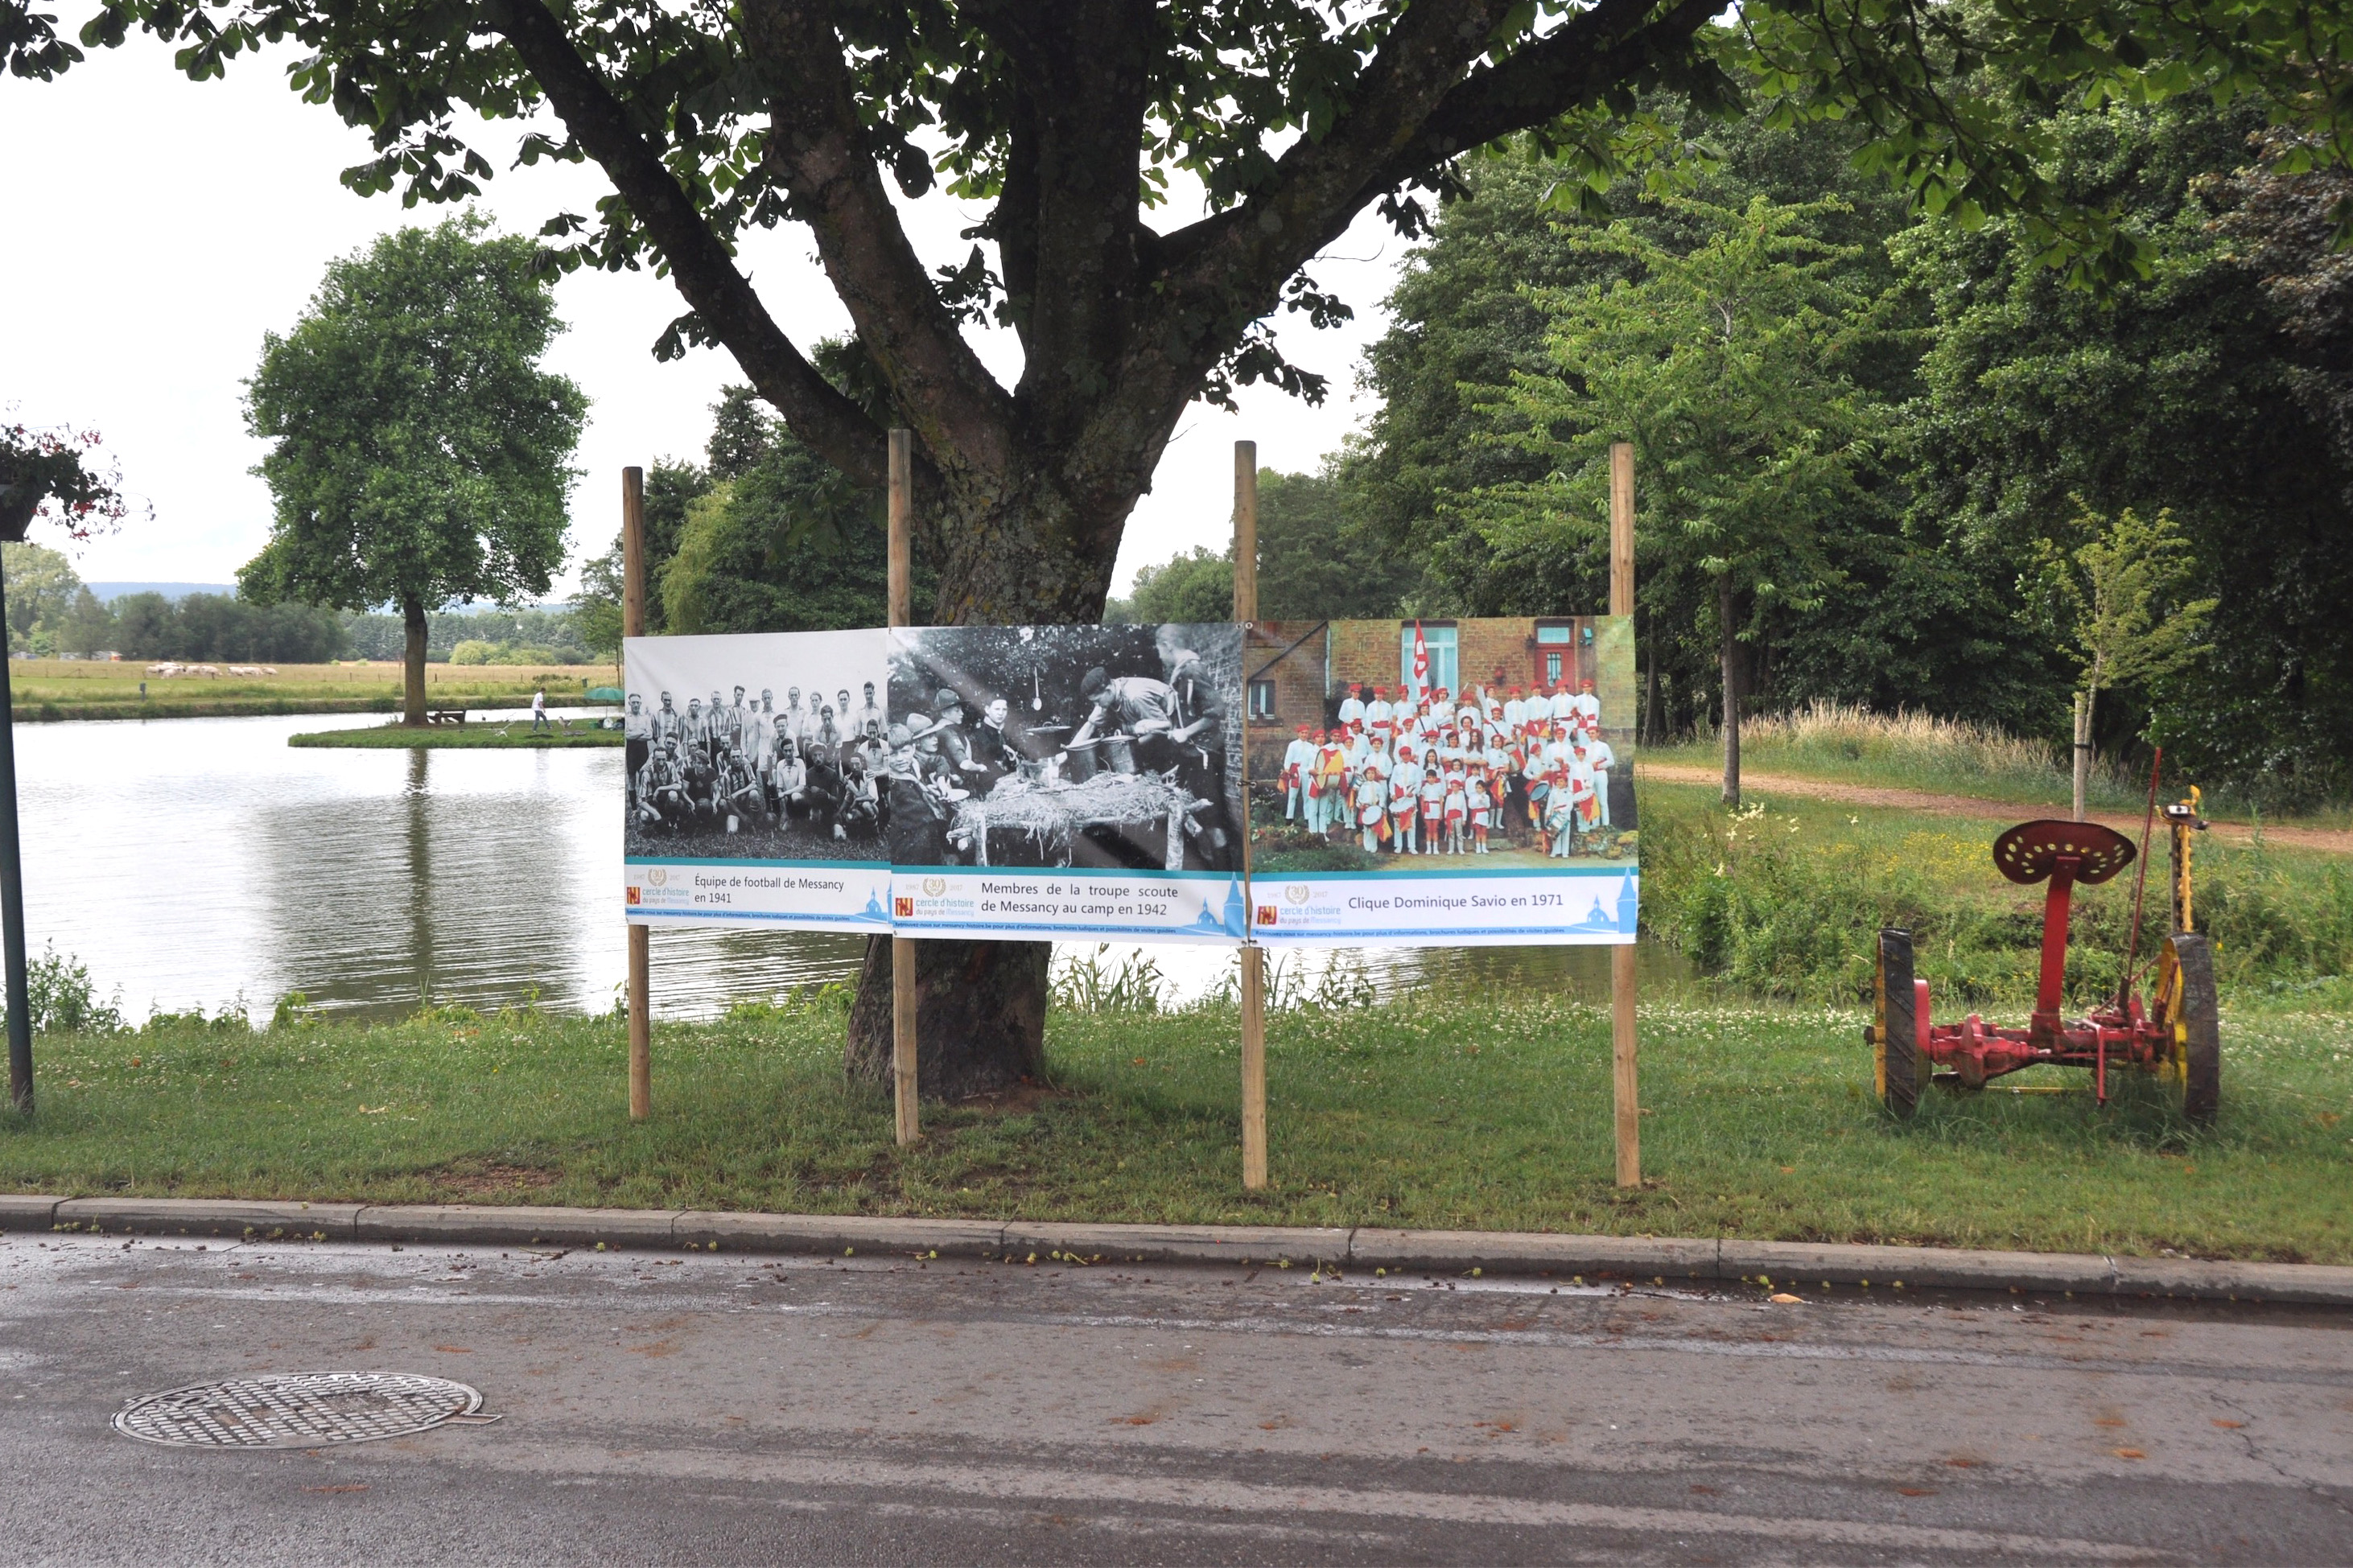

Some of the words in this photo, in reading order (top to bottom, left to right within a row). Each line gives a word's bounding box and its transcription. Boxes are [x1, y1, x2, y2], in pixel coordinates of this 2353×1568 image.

[694, 873, 727, 889] Équipe
[729, 876, 741, 887] de
[744, 876, 781, 888] football
[784, 878, 796, 888] de
[798, 878, 844, 893] Messancy
[929, 879, 941, 888] 30
[982, 883, 1038, 895] Membres
[1046, 883, 1061, 895] de
[1070, 883, 1080, 895] la
[1089, 886, 1130, 899] troupe
[1138, 887, 1178, 898] scoute
[1291, 886, 1304, 895] 30
[694, 895, 706, 903] en
[709, 893, 731, 903] 1941
[916, 899, 938, 907] cercle
[940, 899, 974, 907] d'histoire
[982, 900, 996, 912] de
[1001, 901, 1058, 916] Messancy
[1063, 904, 1077, 913] au
[1082, 905, 1114, 916] camp
[1119, 906, 1133, 914] en
[1138, 903, 1167, 916] 1942
[1349, 896, 1390, 912] Clique
[1395, 896, 1467, 910] Dominique
[1471, 895, 1506, 907] Savio
[1510, 898, 1527, 906] en
[1532, 895, 1564, 906] 1971
[1280, 907, 1303, 915] cercle
[1304, 906, 1341, 915] d'histoire
